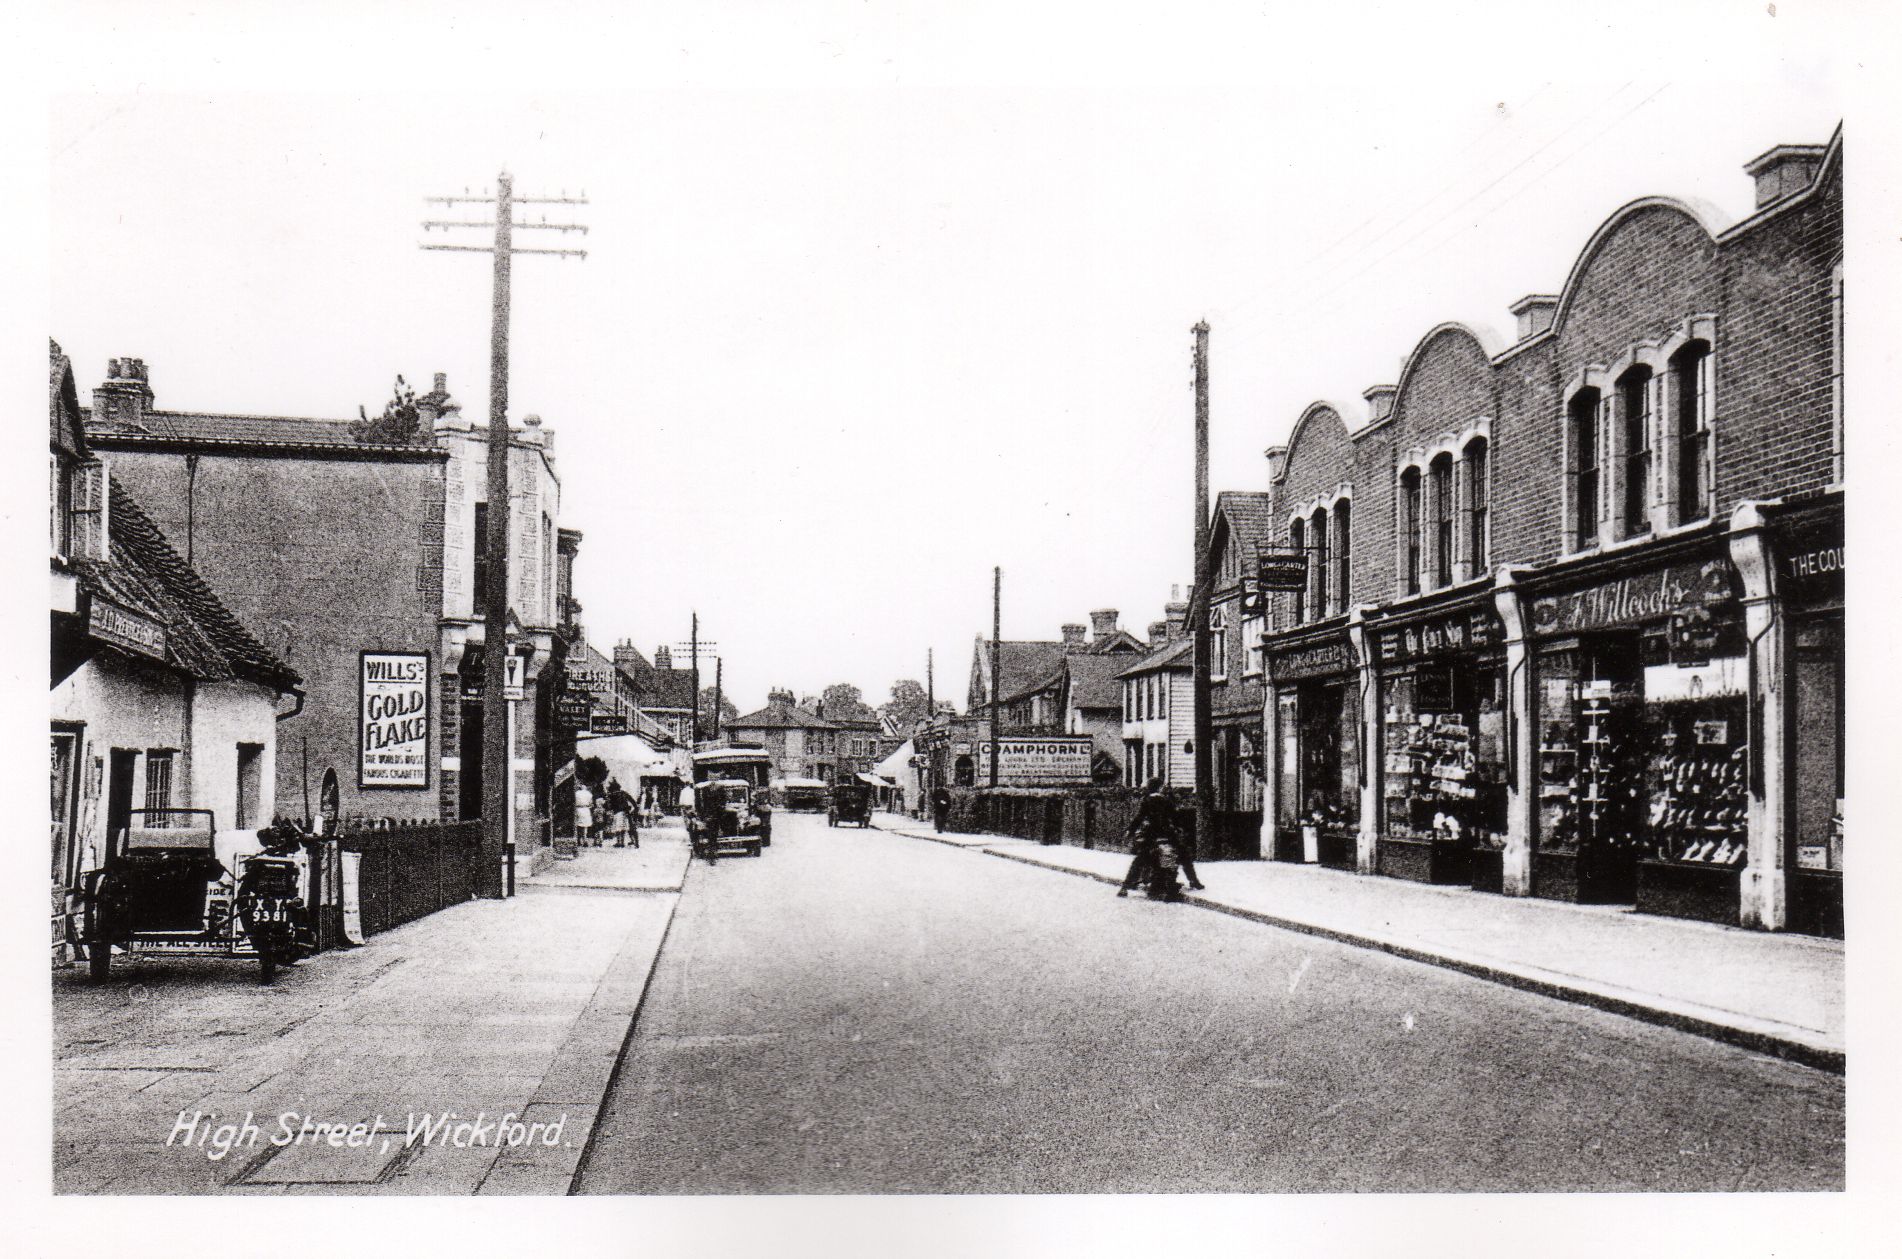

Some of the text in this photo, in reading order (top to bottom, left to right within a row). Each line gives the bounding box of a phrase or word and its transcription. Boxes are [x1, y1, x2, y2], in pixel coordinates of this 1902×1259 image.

[1789, 547, 1846, 577] THE COU
[367, 690, 424, 721] GOLD
[365, 717, 426, 751] FLAKE
[981, 744, 1078, 755] CAMPHORN
[252, 910, 287, 922] 9381
